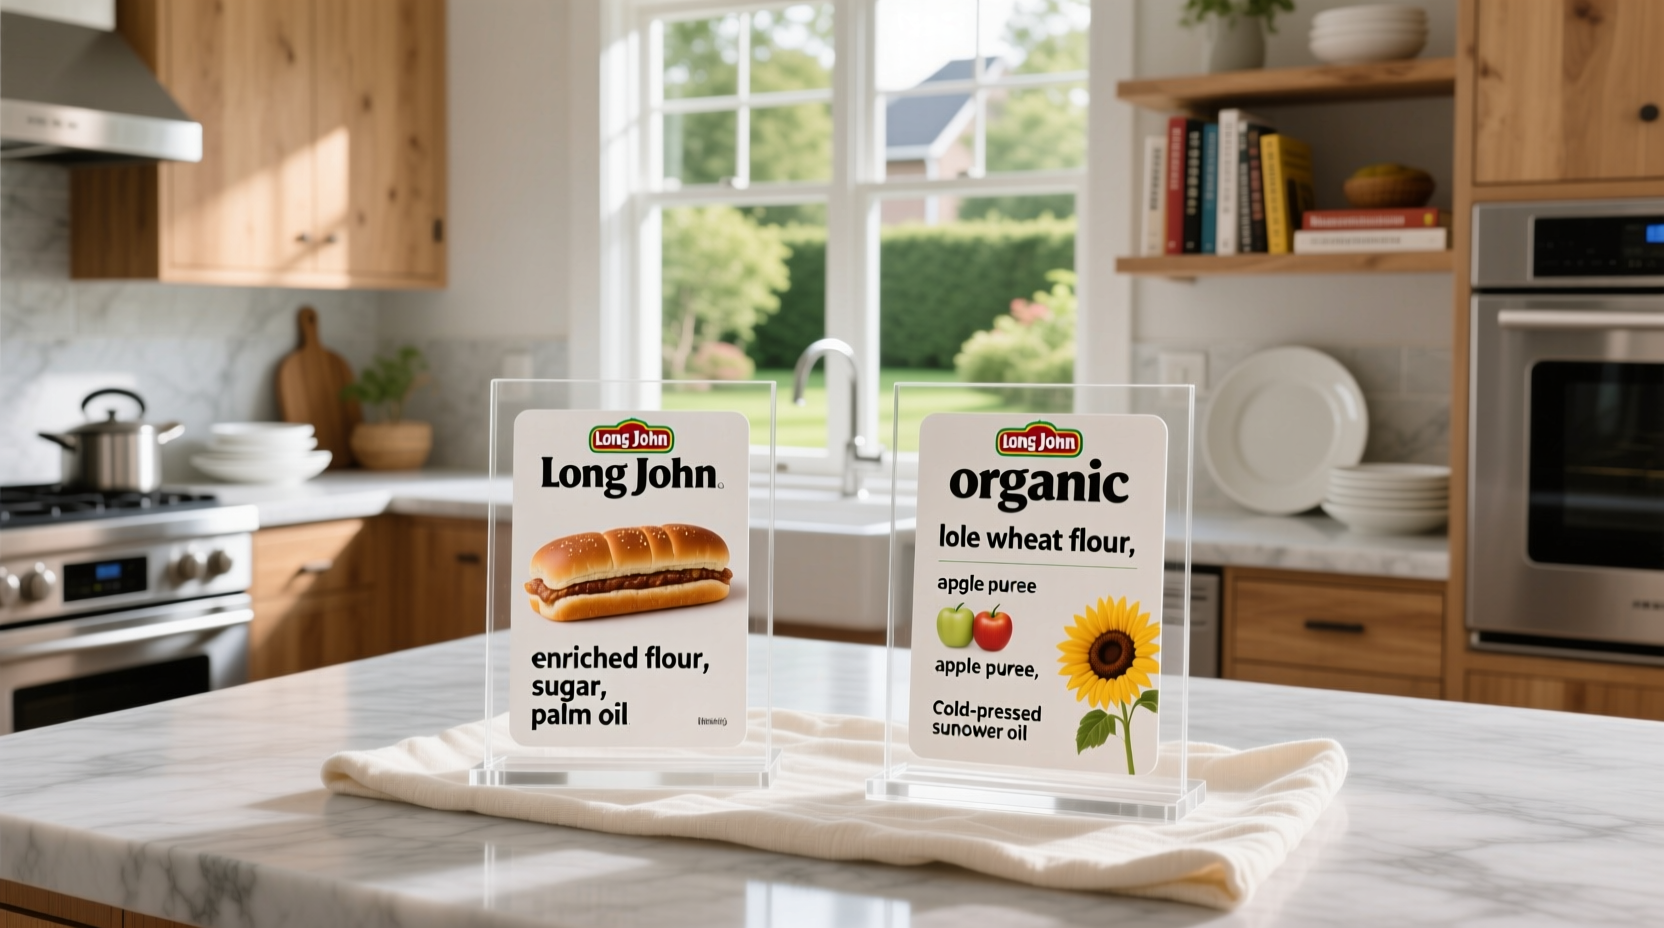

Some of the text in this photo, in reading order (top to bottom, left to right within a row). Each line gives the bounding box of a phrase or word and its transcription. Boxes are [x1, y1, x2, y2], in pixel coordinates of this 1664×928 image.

[595, 430, 668, 448] Long John
[1002, 433, 1076, 451] Long John
[541, 456, 717, 499] Long John
[949, 458, 1130, 513] organic
[939, 523, 1136, 558] lole wheat flour,
[988, 578, 1037, 595] puree
[531, 645, 710, 674] enriched flour,
[935, 657, 1039, 680] apple puree,
[531, 679, 607, 702] sugar,
[531, 702, 628, 731] palm oil
[932, 700, 1042, 722] Cold-pressed
[1006, 724, 1028, 741] oil
